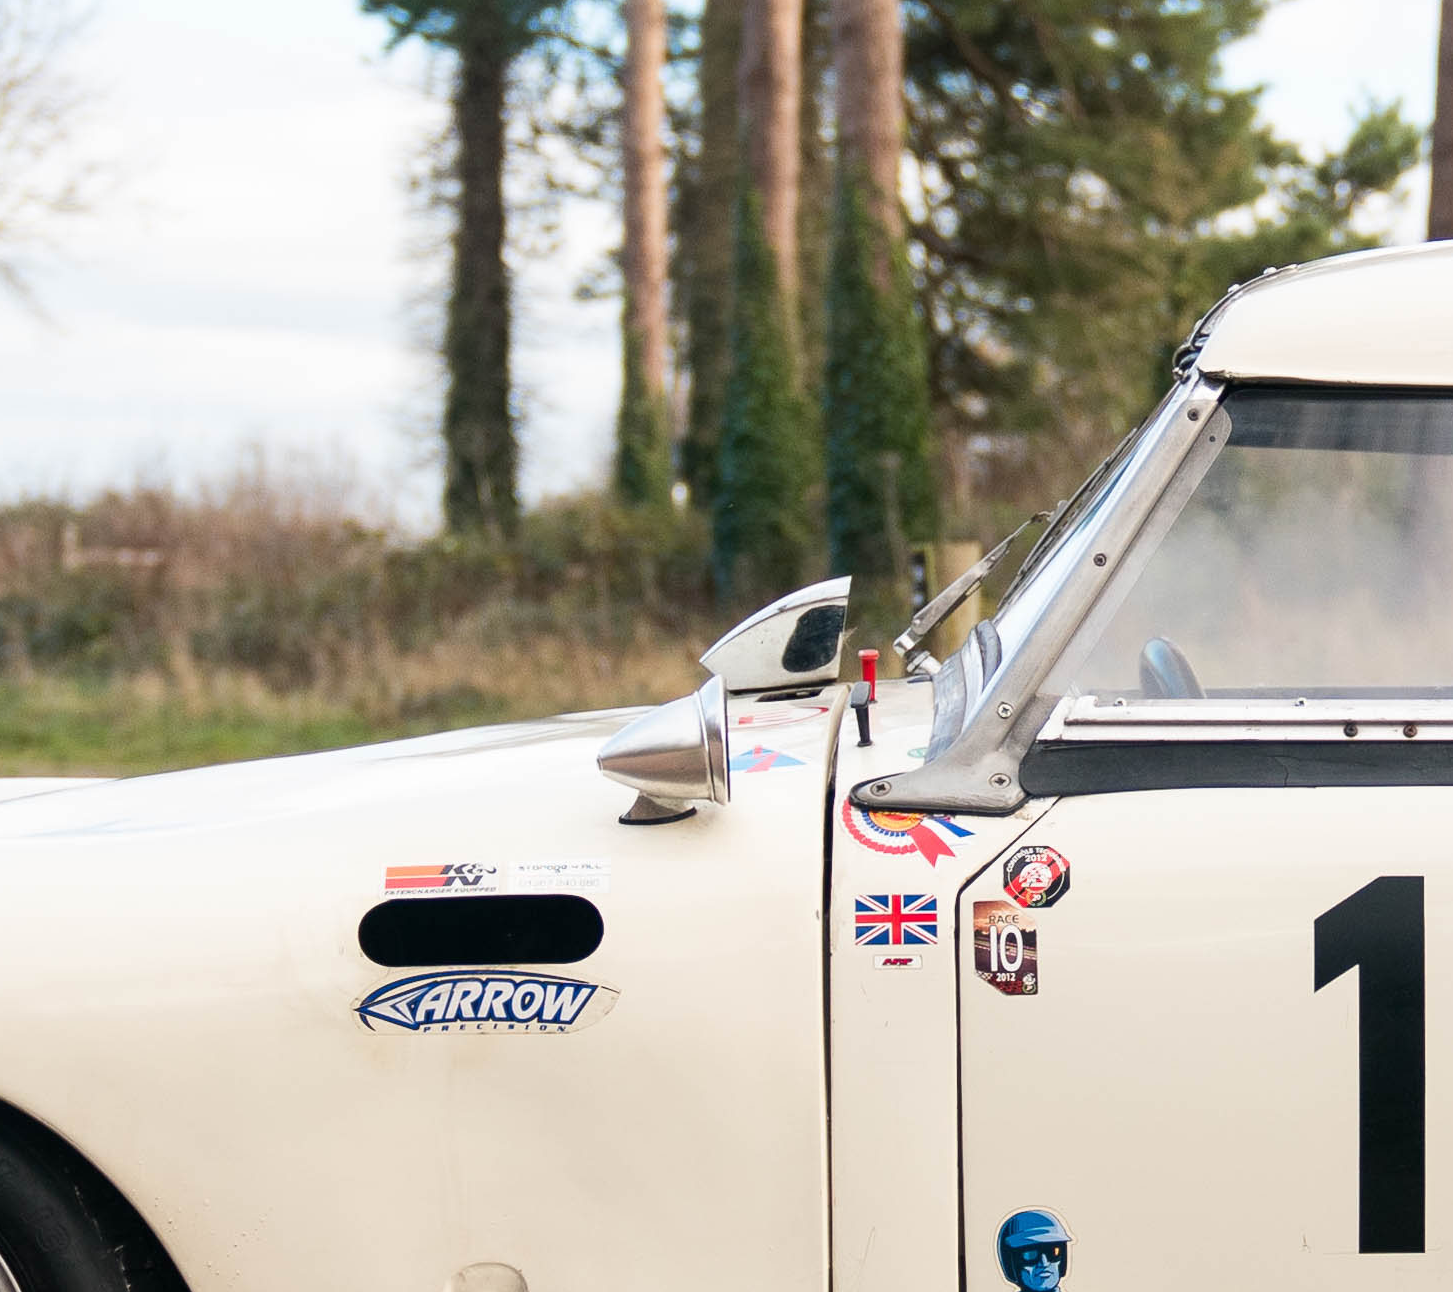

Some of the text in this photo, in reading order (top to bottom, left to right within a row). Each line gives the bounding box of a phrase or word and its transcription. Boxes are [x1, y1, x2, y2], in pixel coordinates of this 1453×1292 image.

[1024, 854, 1048, 862] 2012
[988, 914, 1019, 924] RACE
[989, 924, 1024, 972] 10
[995, 972, 1016, 982] 2012
[414, 979, 595, 1023] ARROW
[423, 1022, 567, 1033] PRECISION
